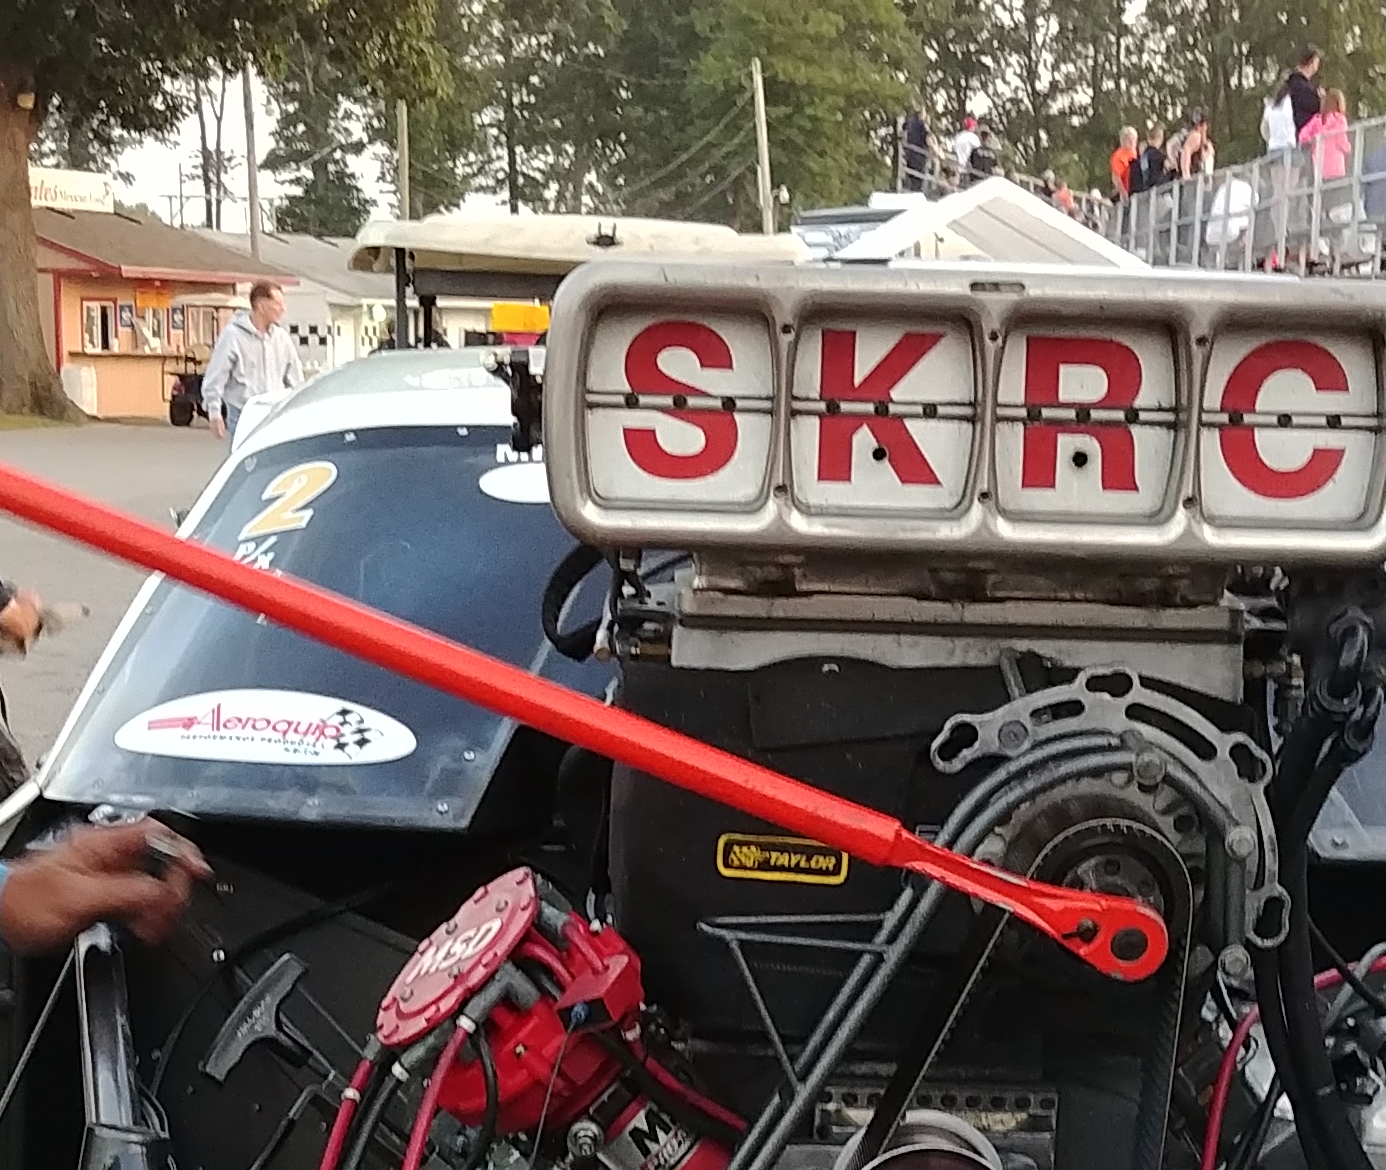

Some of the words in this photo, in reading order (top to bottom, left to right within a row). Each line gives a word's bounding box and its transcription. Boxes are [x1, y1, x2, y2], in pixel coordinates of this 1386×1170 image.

[623, 318, 1351, 500] SKRC
[237, 460, 338, 541] 2
[198, 703, 342, 743] Aeroquip
[769, 849, 836, 872] TAYLOR
[404, 917, 502, 985] MSD
